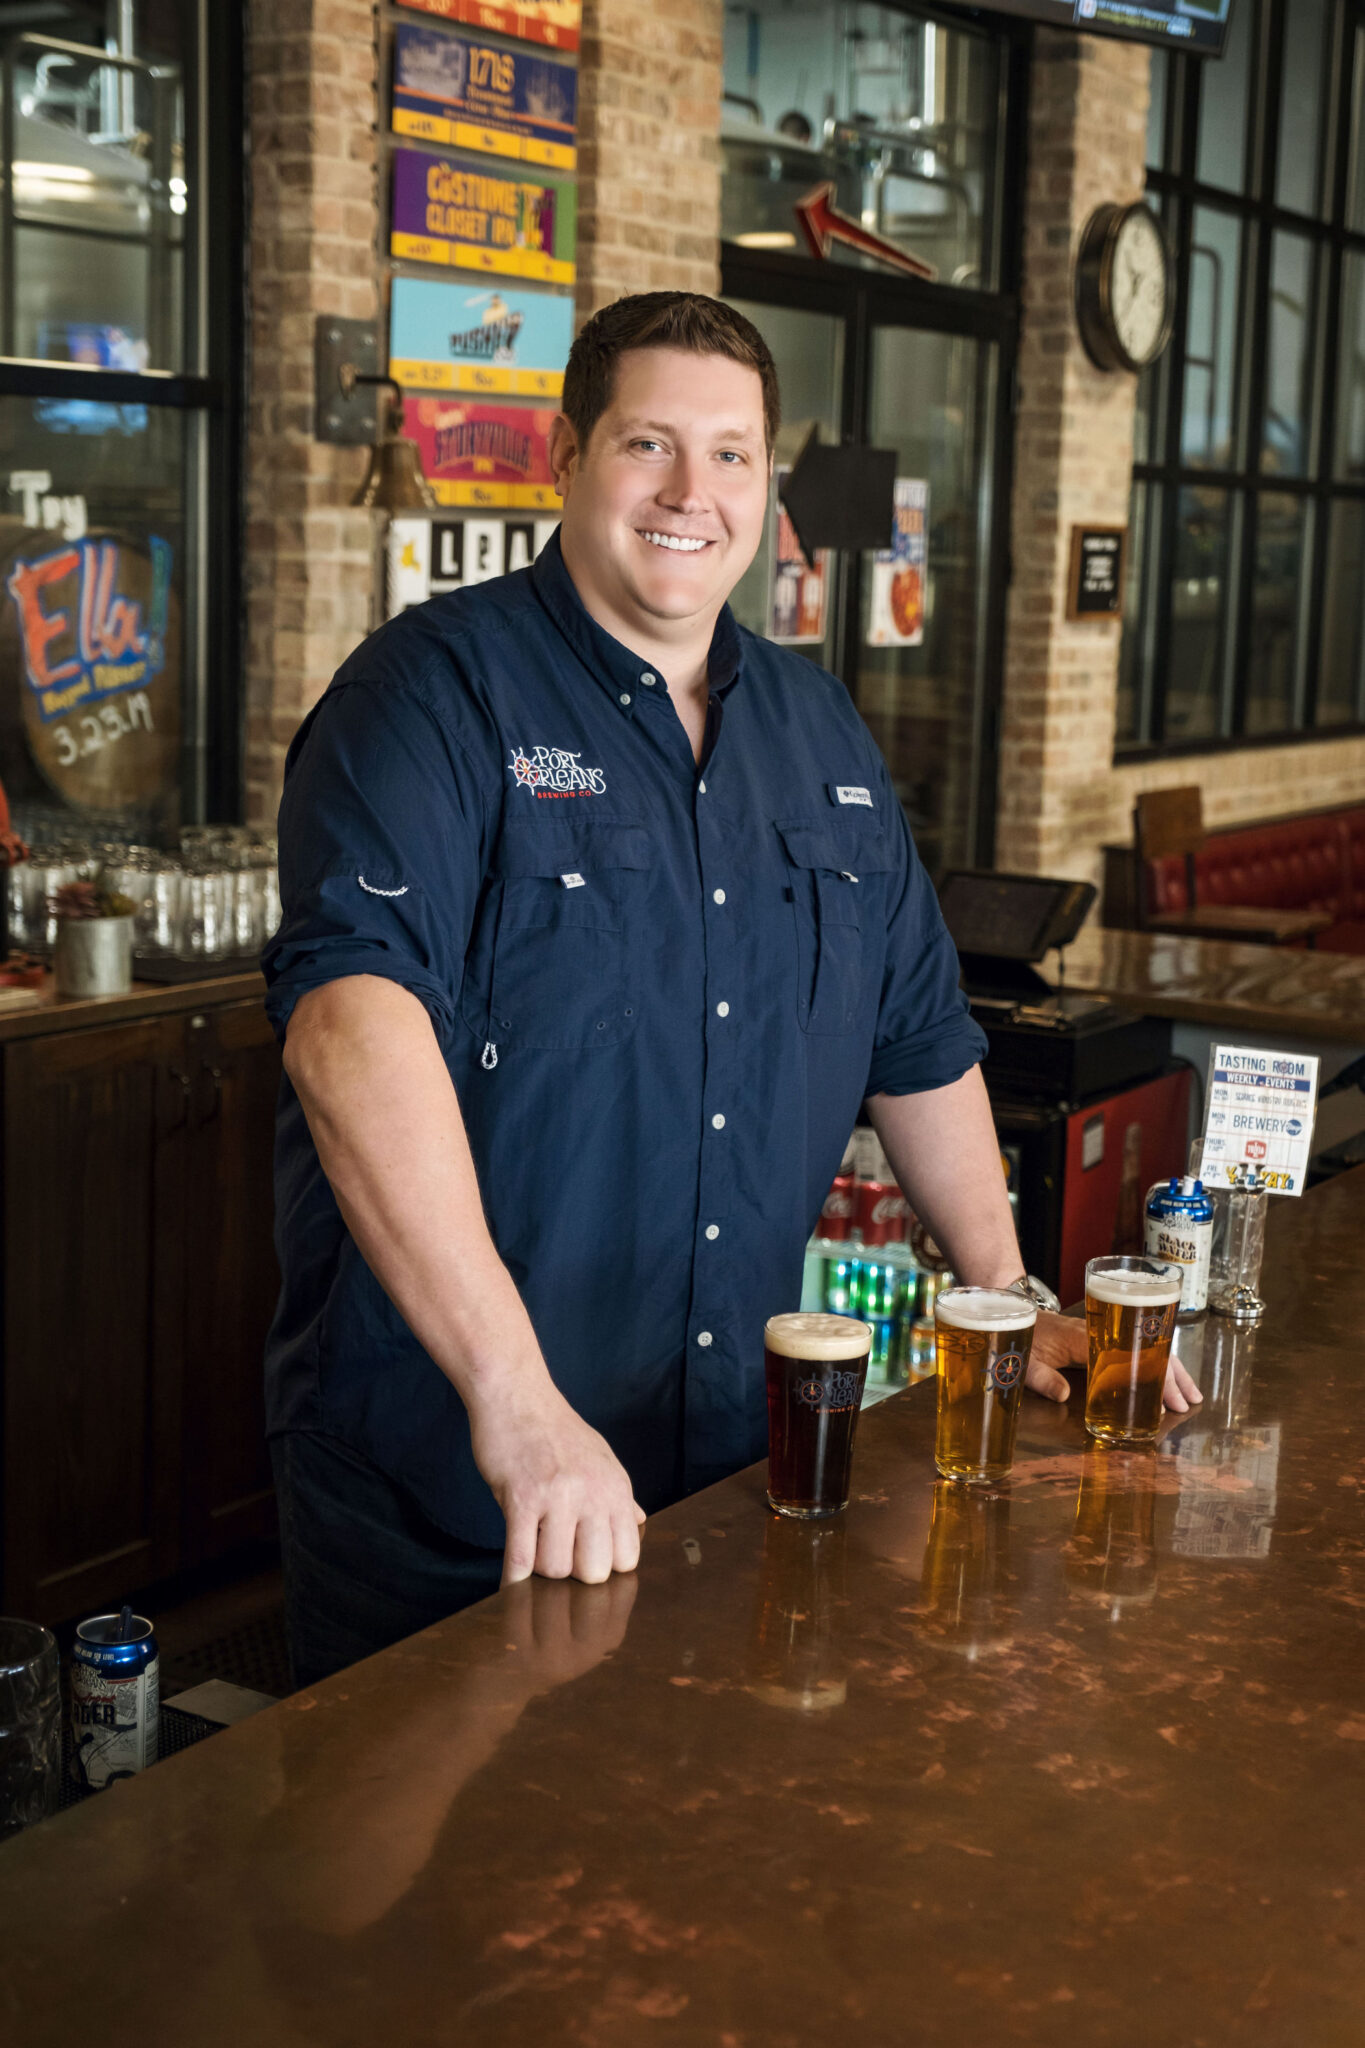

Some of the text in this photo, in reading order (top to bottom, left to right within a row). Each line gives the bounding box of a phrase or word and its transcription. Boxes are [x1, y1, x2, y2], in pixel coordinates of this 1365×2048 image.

[427, 165, 518, 216] COSTUME
[426, 202, 488, 242] CLOSET
[9, 470, 87, 542] Try
[532, 746, 581, 769] PORT
[537, 791, 576, 799] BREWING
[1219, 1054, 1305, 1076] TASTING ROOM
[1226, 1072, 1296, 1090] WEEKLY EVENTS
[1214, 1088, 1228, 1096] MON
[1211, 1112, 1226, 1120] MON
[1233, 1115, 1287, 1133] BREWERY
[1158, 1232, 1196, 1251] SLACK
